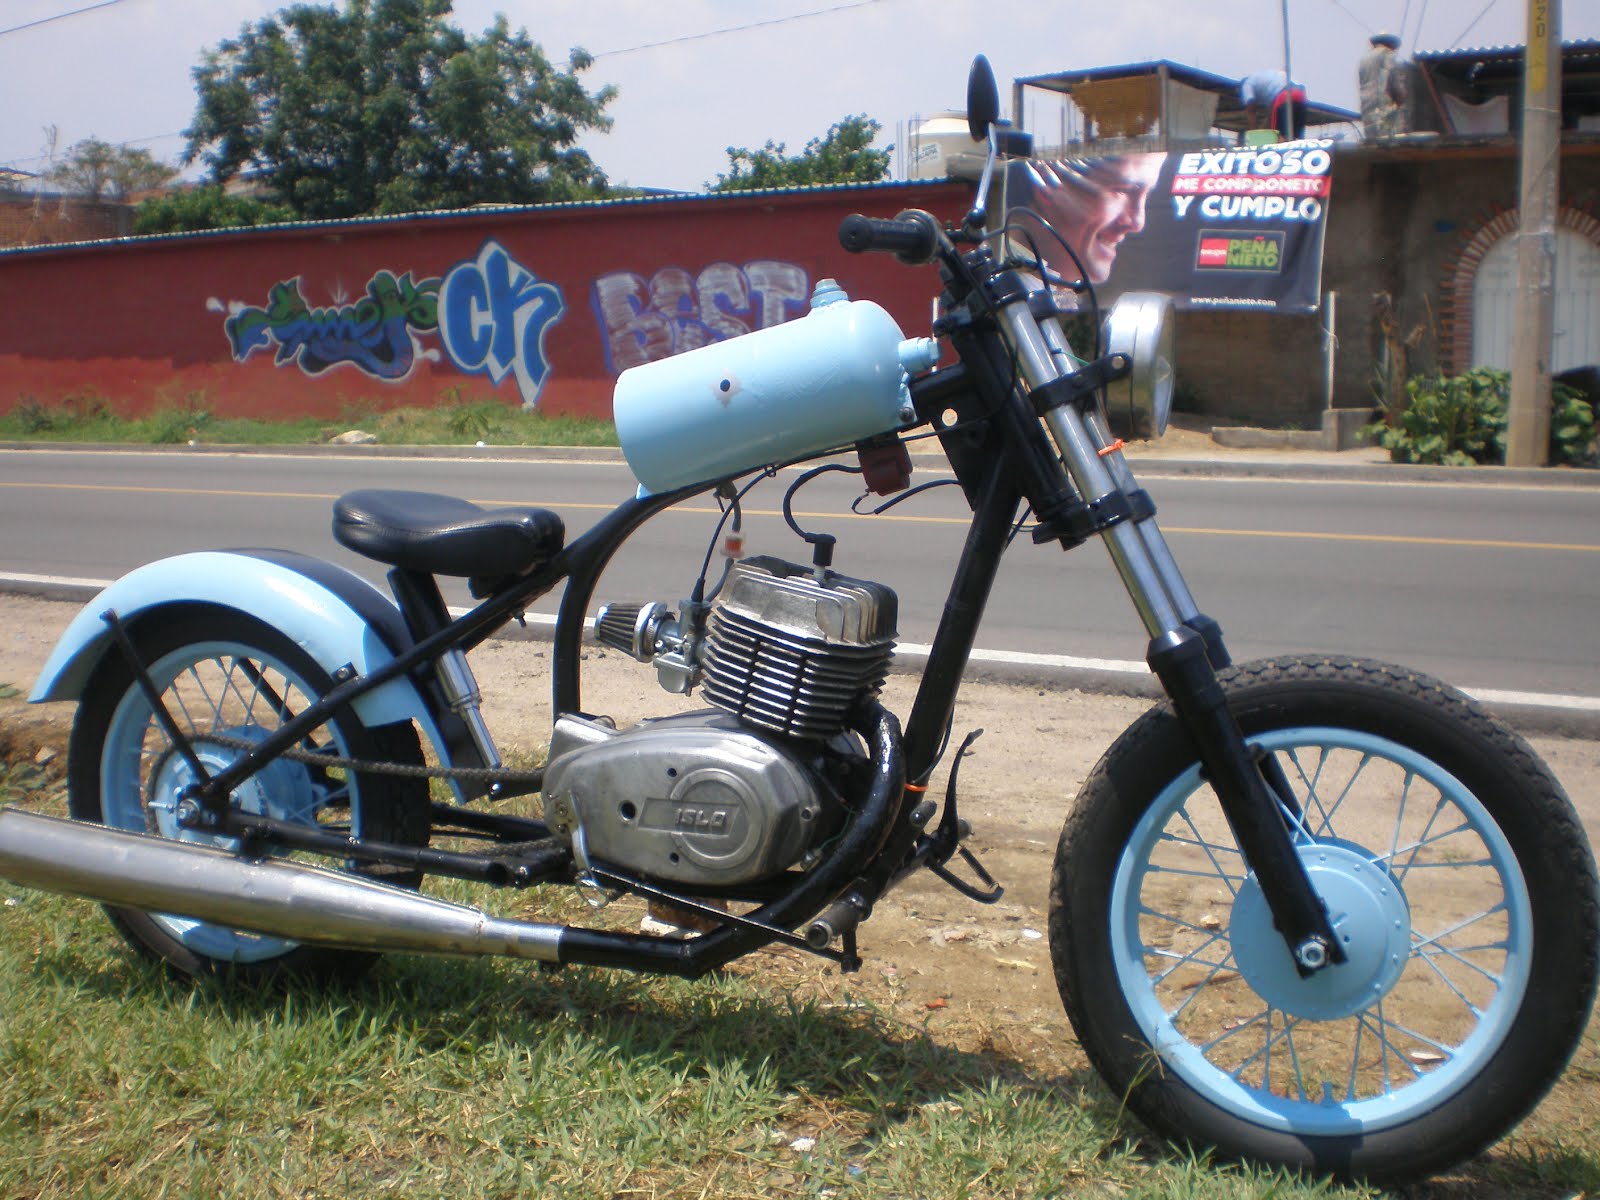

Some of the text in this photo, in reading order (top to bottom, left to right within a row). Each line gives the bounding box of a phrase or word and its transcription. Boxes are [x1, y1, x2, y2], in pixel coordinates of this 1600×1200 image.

[1179, 149, 1332, 175] EXITOSO
[1174, 195, 1322, 221] Y CUMPLO
[1229, 235, 1279, 255] PEÑA
[1226, 253, 1278, 267] NIETO
